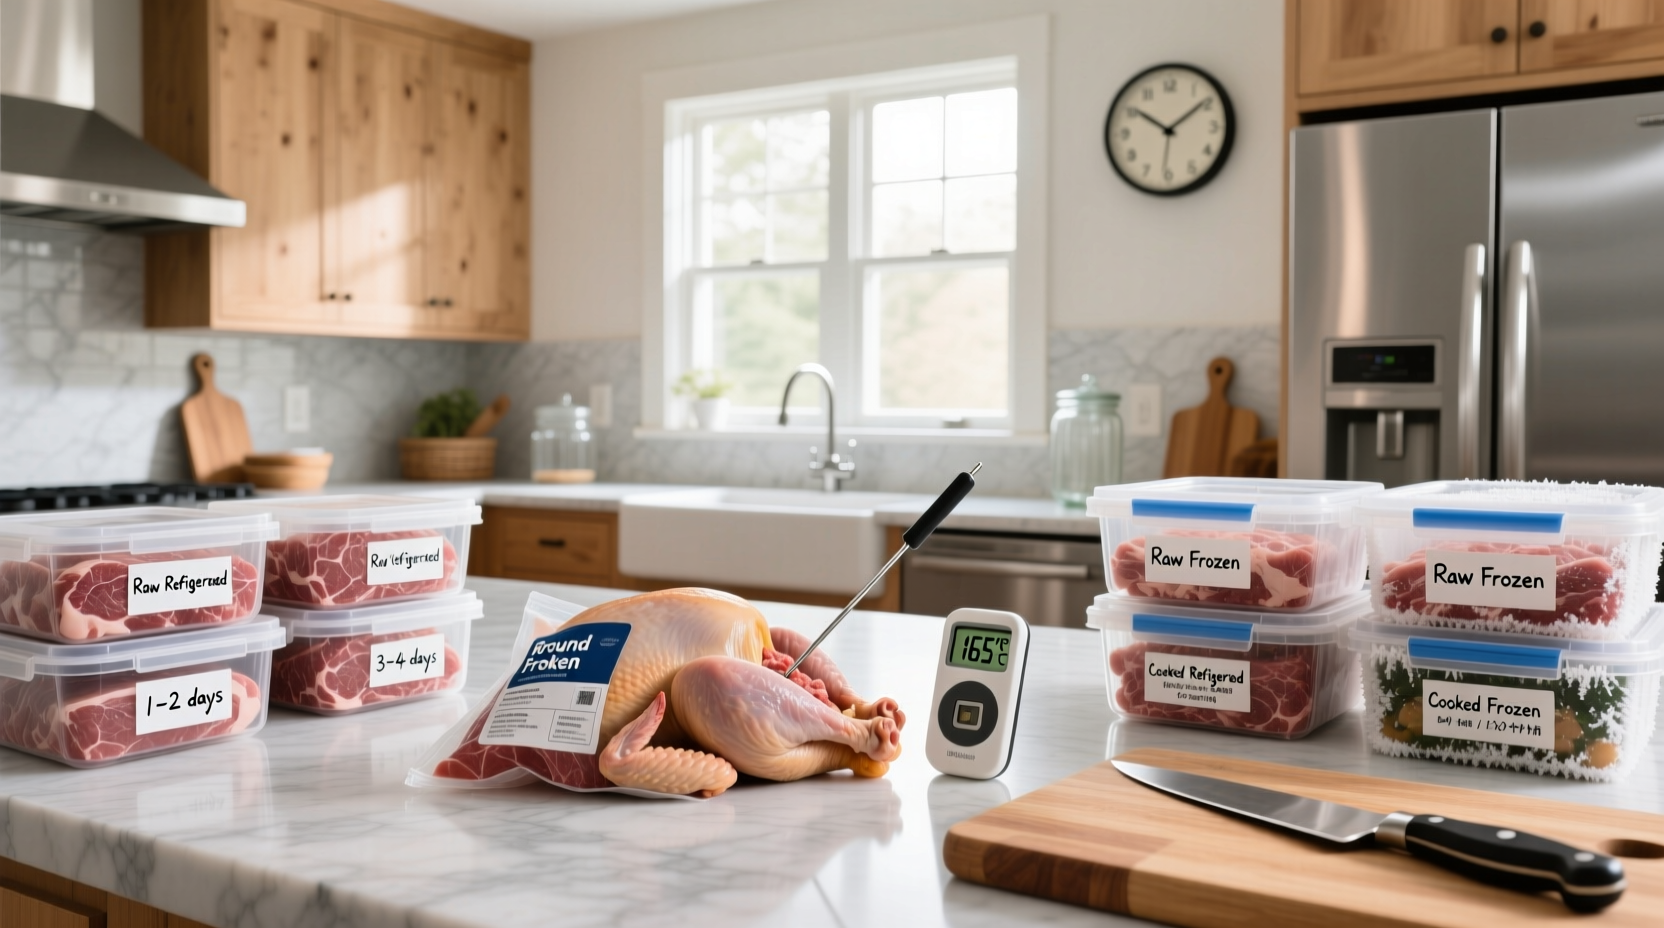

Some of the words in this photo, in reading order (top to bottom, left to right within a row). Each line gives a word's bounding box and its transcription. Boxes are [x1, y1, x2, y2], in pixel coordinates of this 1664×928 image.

[1163, 79, 1177, 93] 12
[1121, 126, 1131, 141] 9
[1208, 119, 1219, 134] 3
[1202, 143, 1212, 156] 4
[1143, 163, 1151, 177] 7
[1187, 160, 1197, 175] 5
[1151, 546, 1184, 567] Raw
[1189, 550, 1240, 570] Frozen
[1433, 562, 1474, 586] Raw
[1481, 566, 1545, 589] Frozen
[133, 576, 160, 595] Raw
[376, 651, 406, 673] 3-4
[409, 646, 437, 674] days
[147, 691, 181, 717] 1-2
[187, 686, 224, 716] days
[1428, 691, 1481, 713] Cooked
[1487, 697, 1541, 718] Frozen
